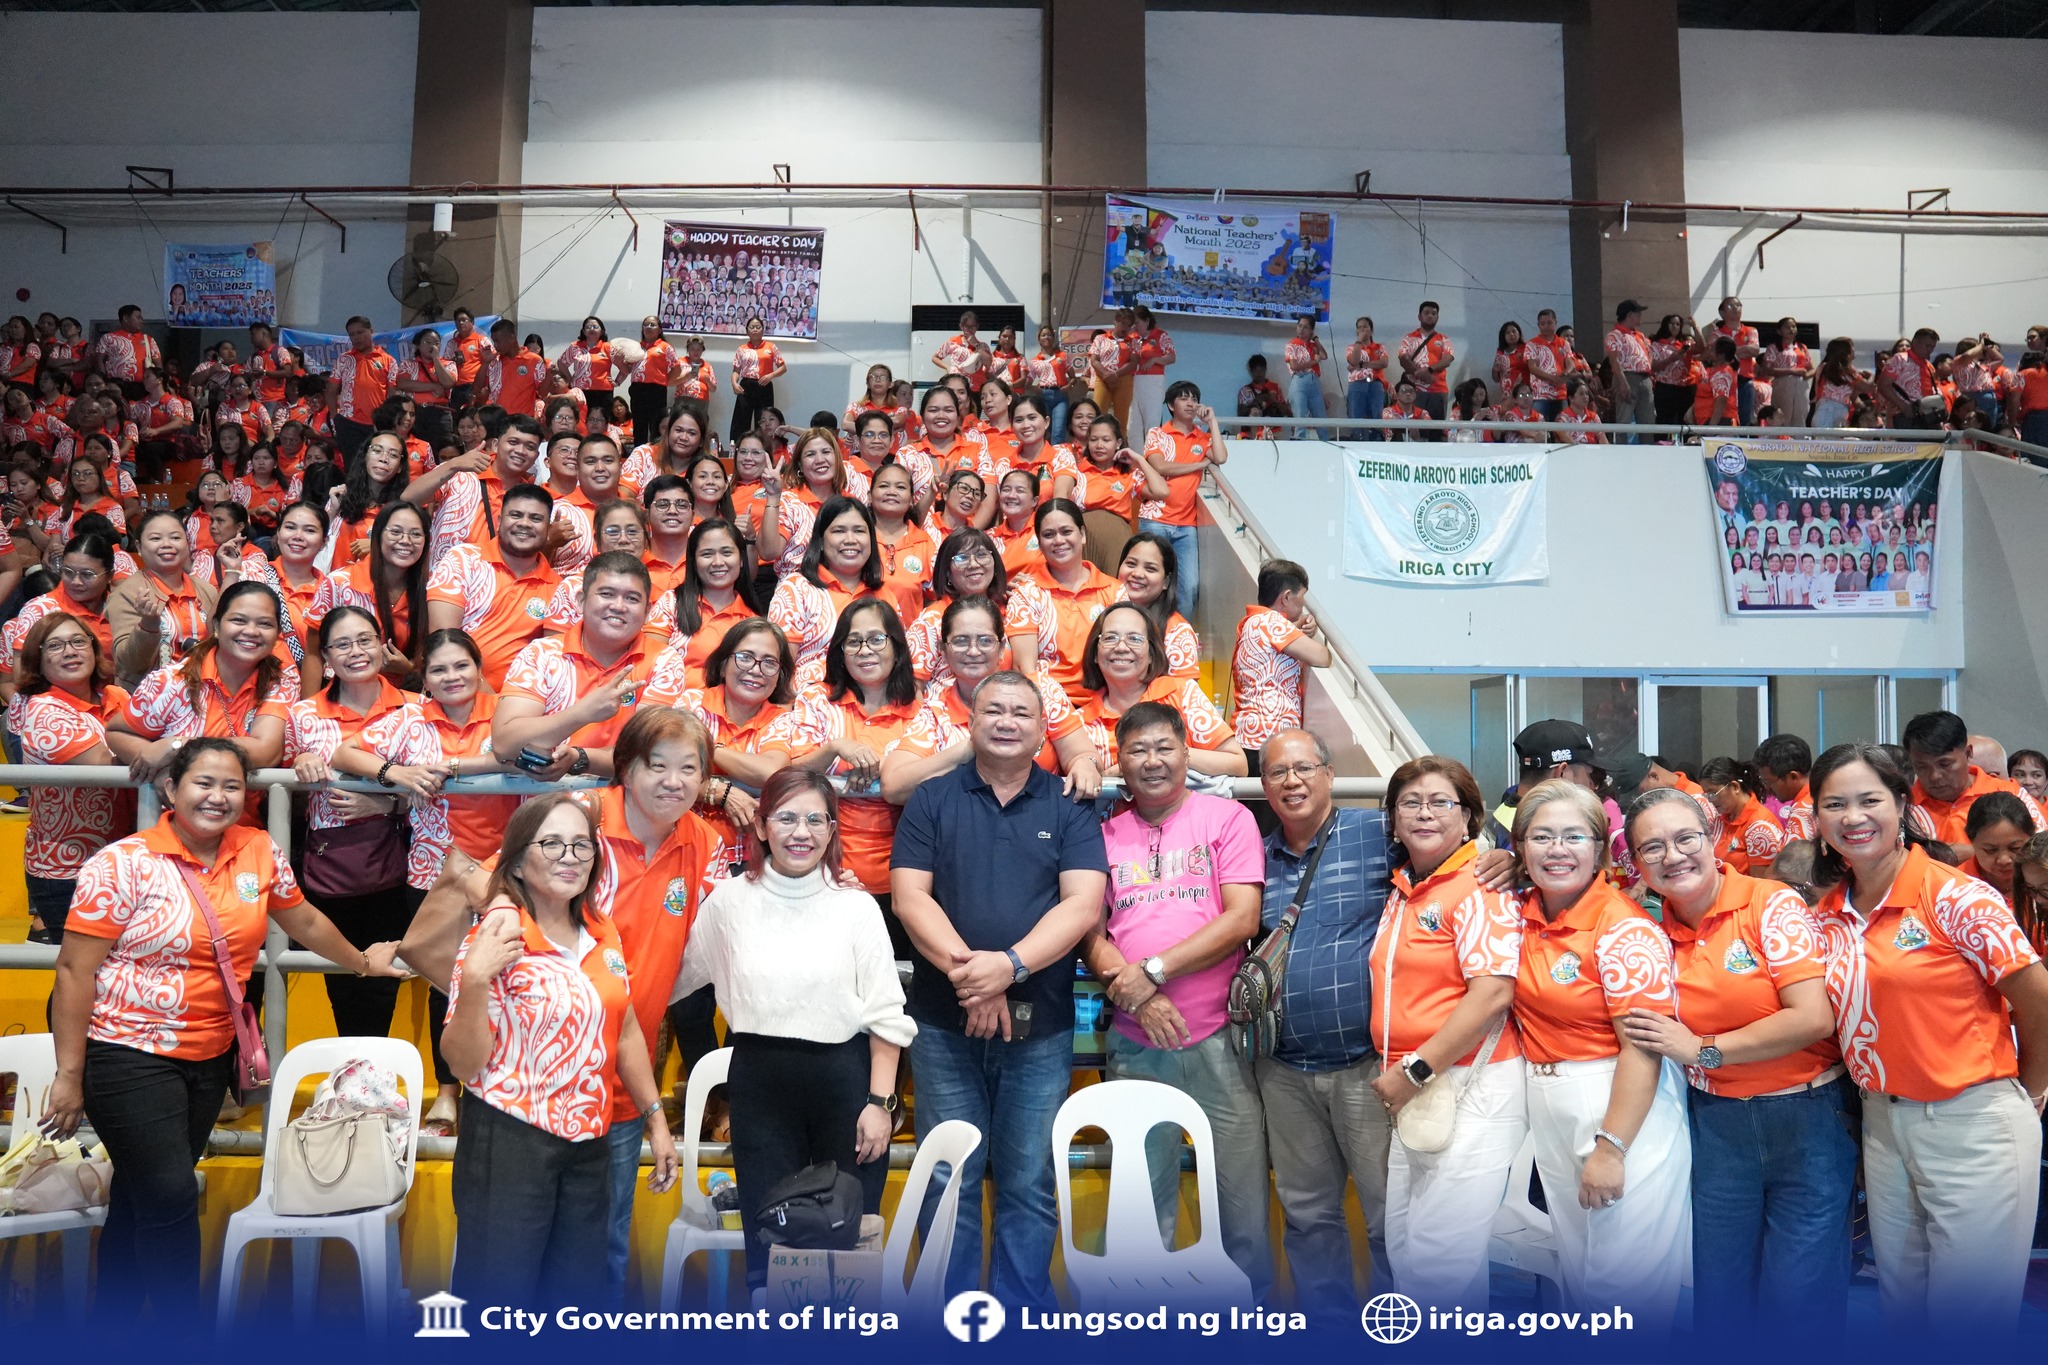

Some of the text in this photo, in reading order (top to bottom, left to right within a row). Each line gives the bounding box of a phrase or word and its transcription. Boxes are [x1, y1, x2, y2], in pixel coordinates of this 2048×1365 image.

[1174, 225, 1277, 241] National Teachers'
[690, 232, 817, 250] HAPPY TEACHER'S DAY
[1185, 236, 1222, 247] Month
[1225, 239, 1261, 250] 2025
[189, 268, 245, 279] TEACHERS'
[189, 281, 253, 291] MONTH 2025
[1136, 292, 1151, 301] San
[1154, 294, 1186, 305] Agustin
[1238, 301, 1265, 310] Senior
[1266, 302, 1286, 314] High
[1286, 304, 1316, 314] School
[1798, 444, 1850, 454] NATIONAL
[1852, 445, 1878, 454] HIGH
[1880, 445, 1918, 454] SCHOOL
[1358, 459, 1533, 484] ZEFERINO ARROYO HIGH SCHOOL
[1825, 469, 1866, 479] HAPPY
[1789, 486, 1903, 500] TEACHER'S DAY
[1417, 491, 1477, 543] ZEFERINO ARROYO HIGH SCHOOL
[1399, 560, 1494, 576] IRIGA CITY
[1476, 1048, 1492, 1074] CANADA
[772, 1255, 787, 1266] 48
[790, 1255, 799, 1266] X
